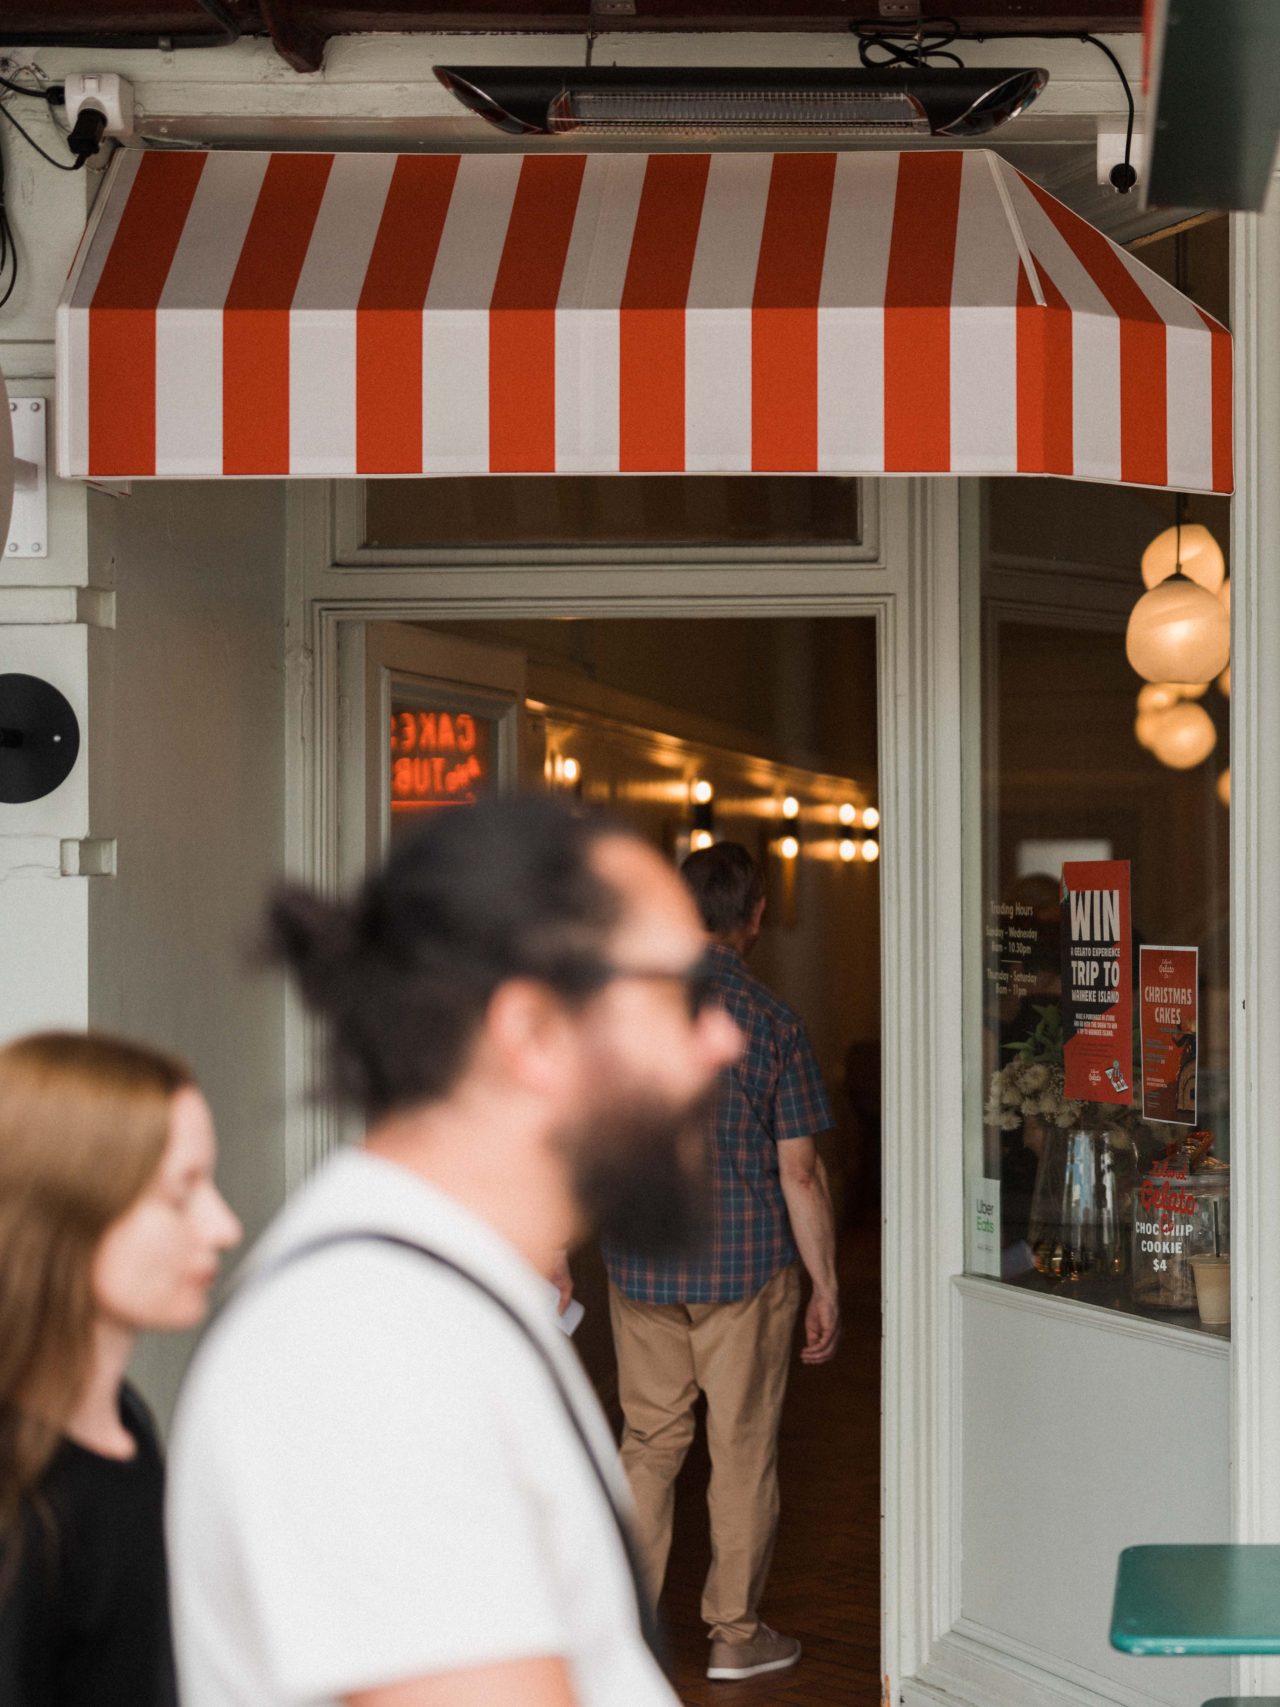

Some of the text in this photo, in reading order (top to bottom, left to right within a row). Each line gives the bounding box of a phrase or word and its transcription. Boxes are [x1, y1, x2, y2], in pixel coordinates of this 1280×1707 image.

[990, 901, 1034, 919] Trading Hours
[1070, 889, 1120, 941] WIN
[1008, 927, 1038, 942] Wednesday
[1008, 942, 1032, 956] 10.30pm
[1074, 947, 1092, 957] GELATO
[1092, 947, 1120, 957] EXPERIENCE
[1013, 970, 1037, 985] Saturday
[1071, 960, 1120, 987] TRIP TO
[1098, 990, 1120, 1003] ISLAND
[1144, 986, 1193, 1005] CHRISTMAS
[1154, 1007, 1181, 1025] CAKES
[1141, 1179, 1196, 1217] Gelato
[976, 1199, 995, 1216] Uber
[976, 1216, 995, 1233] Eats
[1135, 1221, 1160, 1236] CHOC
[1141, 1240, 1183, 1254] COOKIE
[1152, 1258, 1167, 1272] $4
